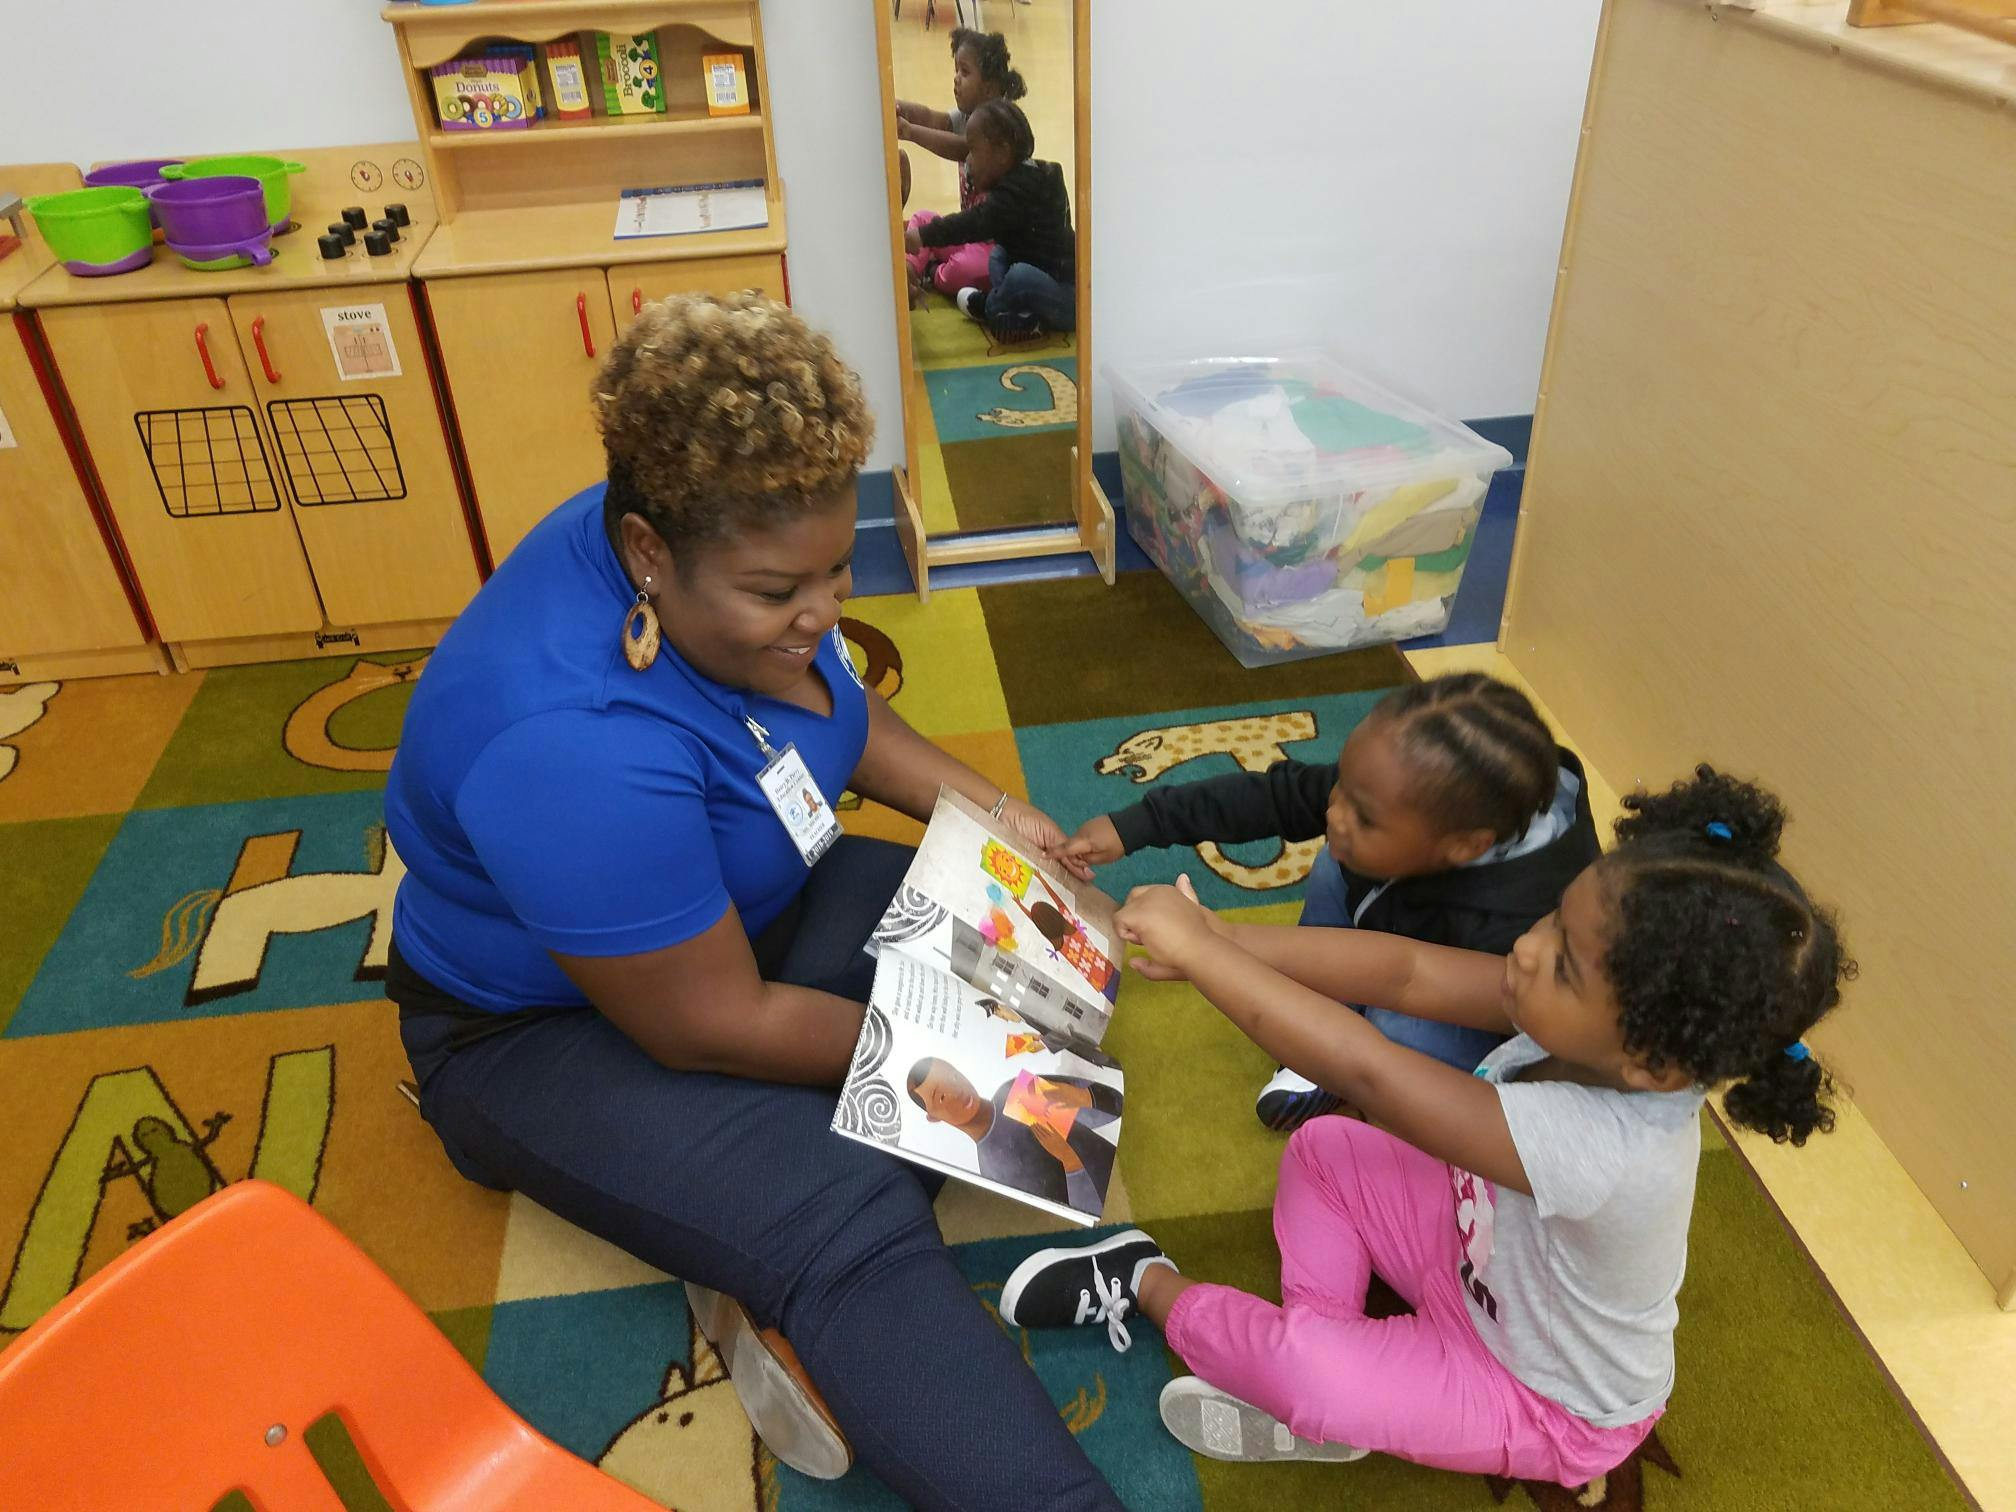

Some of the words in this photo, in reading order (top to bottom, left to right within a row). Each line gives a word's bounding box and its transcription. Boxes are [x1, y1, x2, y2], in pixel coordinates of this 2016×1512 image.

[616, 44, 633, 97] Broccoli
[643, 63, 654, 75] 4
[456, 81, 500, 93] Donuts
[478, 111, 488, 123] 5
[337, 309, 372, 321] stove
